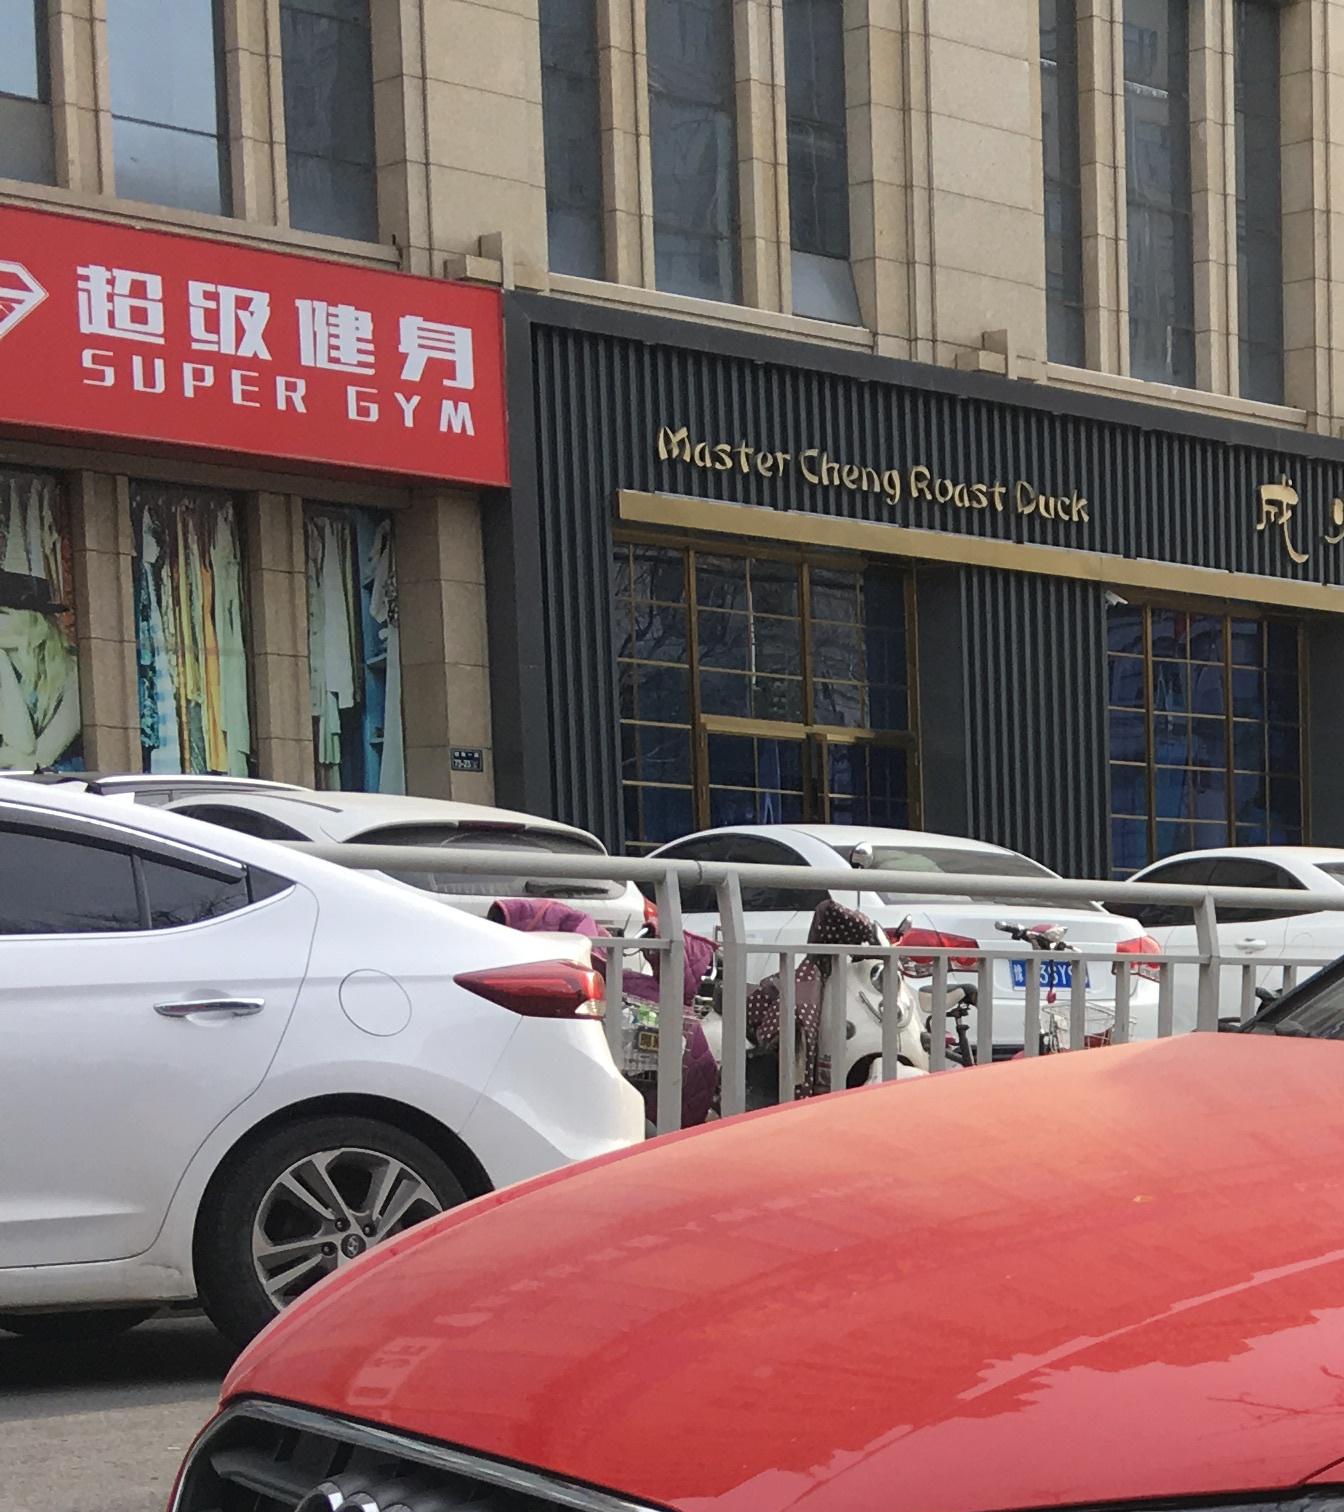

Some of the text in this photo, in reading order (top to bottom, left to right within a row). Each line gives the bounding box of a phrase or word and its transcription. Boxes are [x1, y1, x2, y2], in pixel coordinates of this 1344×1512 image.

[76, 264, 475, 390] 超级健身
[81, 348, 475, 437] SUPER GYM
[658, 426, 1089, 523] Master Cheng Roast Duck
